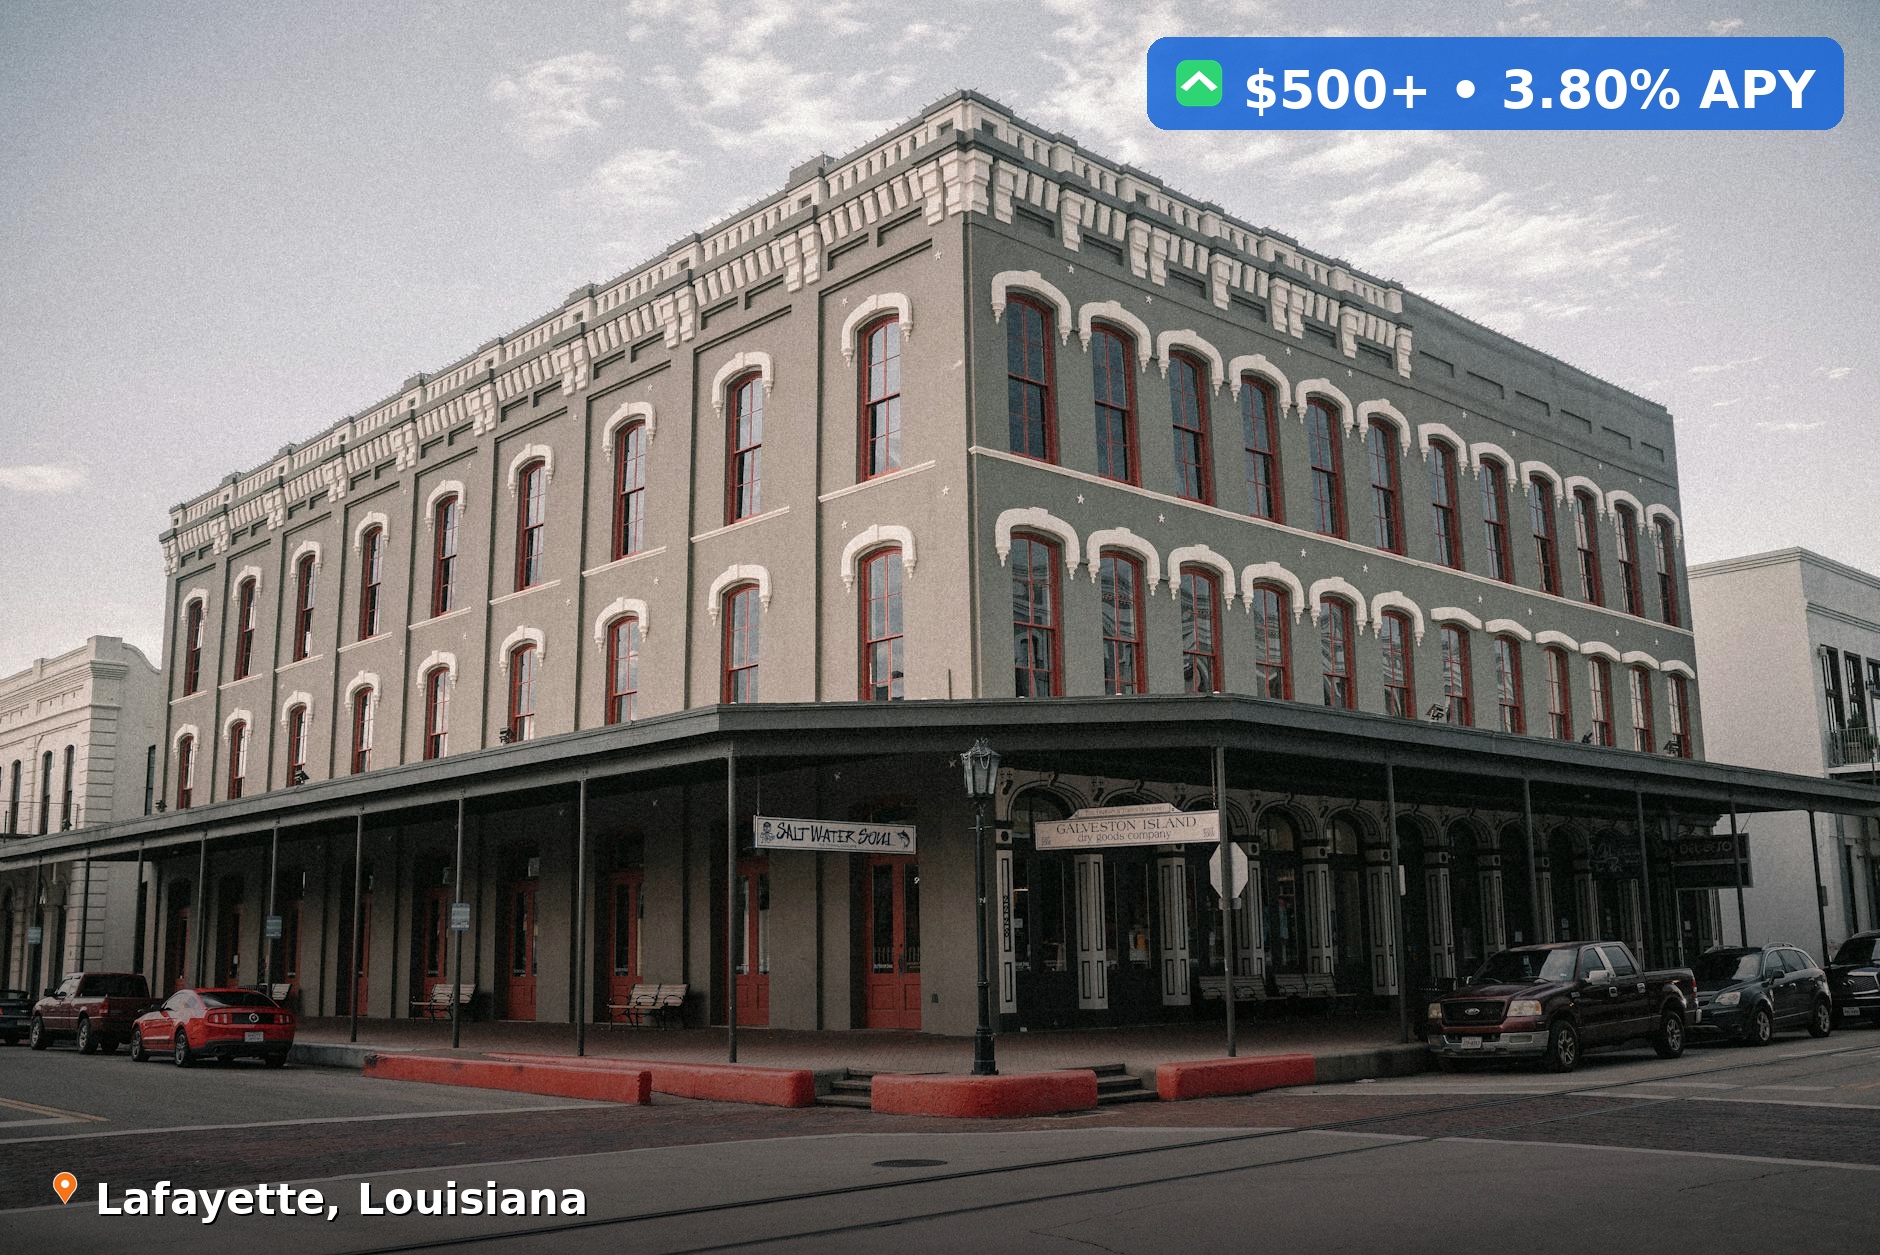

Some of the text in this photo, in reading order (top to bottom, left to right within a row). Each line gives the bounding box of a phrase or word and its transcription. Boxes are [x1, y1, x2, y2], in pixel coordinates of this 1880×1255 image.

[776, 821, 810, 841] SALT
[810, 825, 857, 843] WATER
[1056, 816, 1197, 835] GALVESTON ISLAND
[1077, 829, 1172, 844] dry goods company
